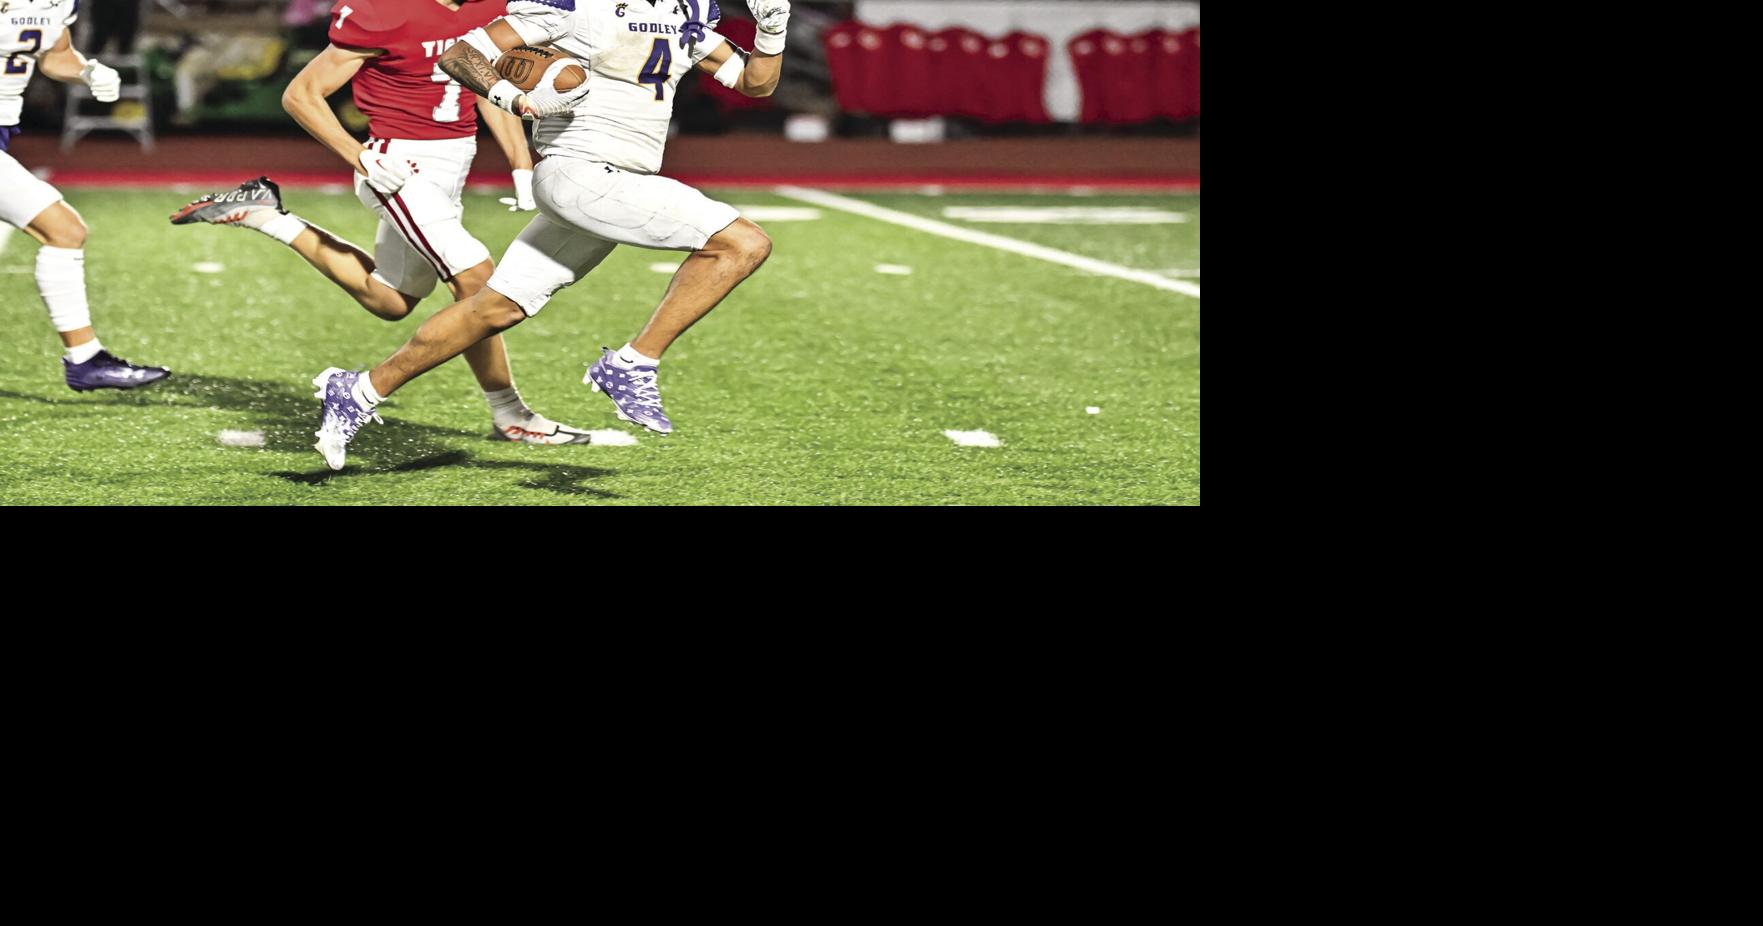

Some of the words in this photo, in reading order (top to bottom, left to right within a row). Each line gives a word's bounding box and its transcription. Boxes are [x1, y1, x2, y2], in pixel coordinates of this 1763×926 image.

[335, 5, 354, 30] 7
[628, 22, 678, 35] GODLEY
[4, 29, 42, 75] 2
[638, 37, 672, 101] 4
